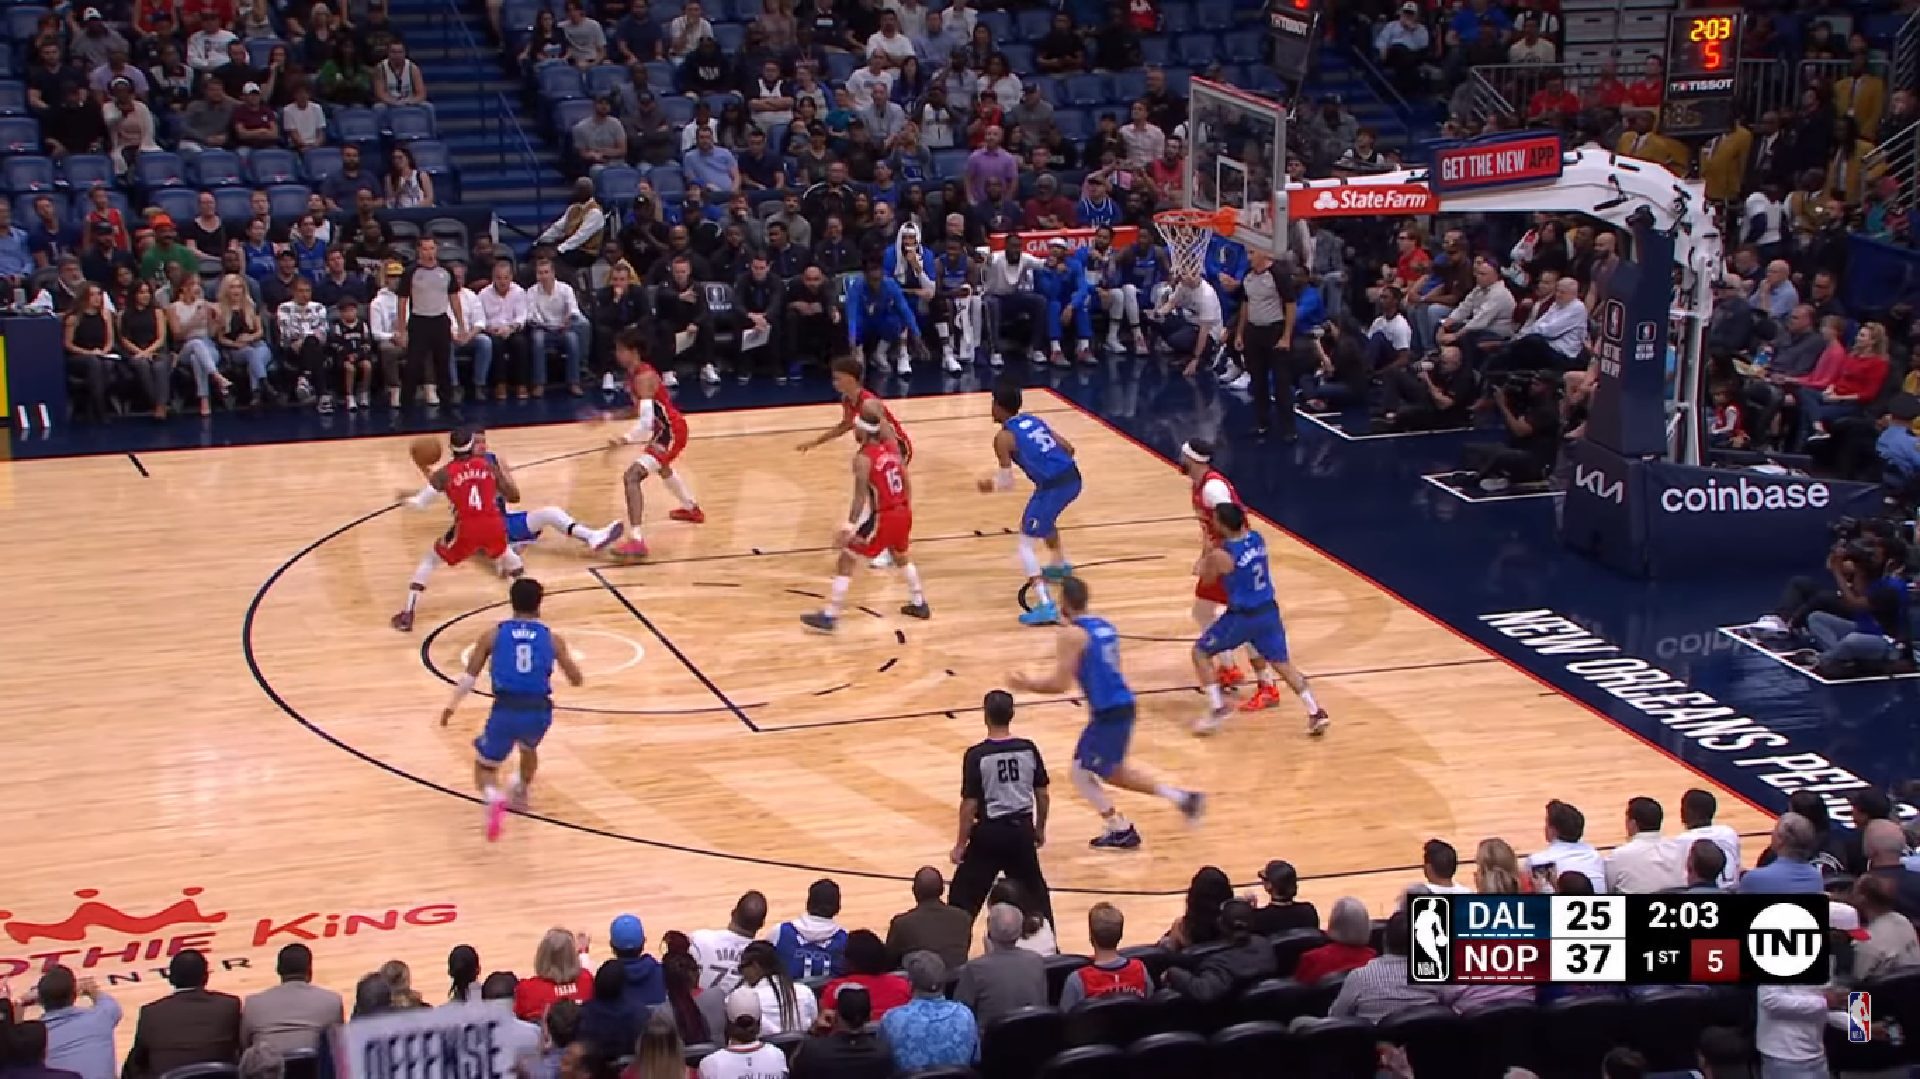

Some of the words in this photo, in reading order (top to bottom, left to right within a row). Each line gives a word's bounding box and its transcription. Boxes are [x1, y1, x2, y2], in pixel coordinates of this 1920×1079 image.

[1690, 17, 1731, 41] 2:03
[1704, 41, 1720, 68] 5
[1689, 79, 1733, 91] TISSOT
[1442, 157, 1467, 181] GET
[1469, 154, 1494, 178] THE
[1496, 149, 1526, 175] NEW
[1529, 146, 1554, 170] APP
[468, 484, 482, 511] 4
[1661, 478, 1830, 512] coinbase
[1251, 562, 1267, 590] 2
[515, 643, 533, 673] 8
[1478, 608, 1620, 655] NEW
[1566, 658, 1789, 751] ORLEANS
[996, 758, 1020, 784] 26
